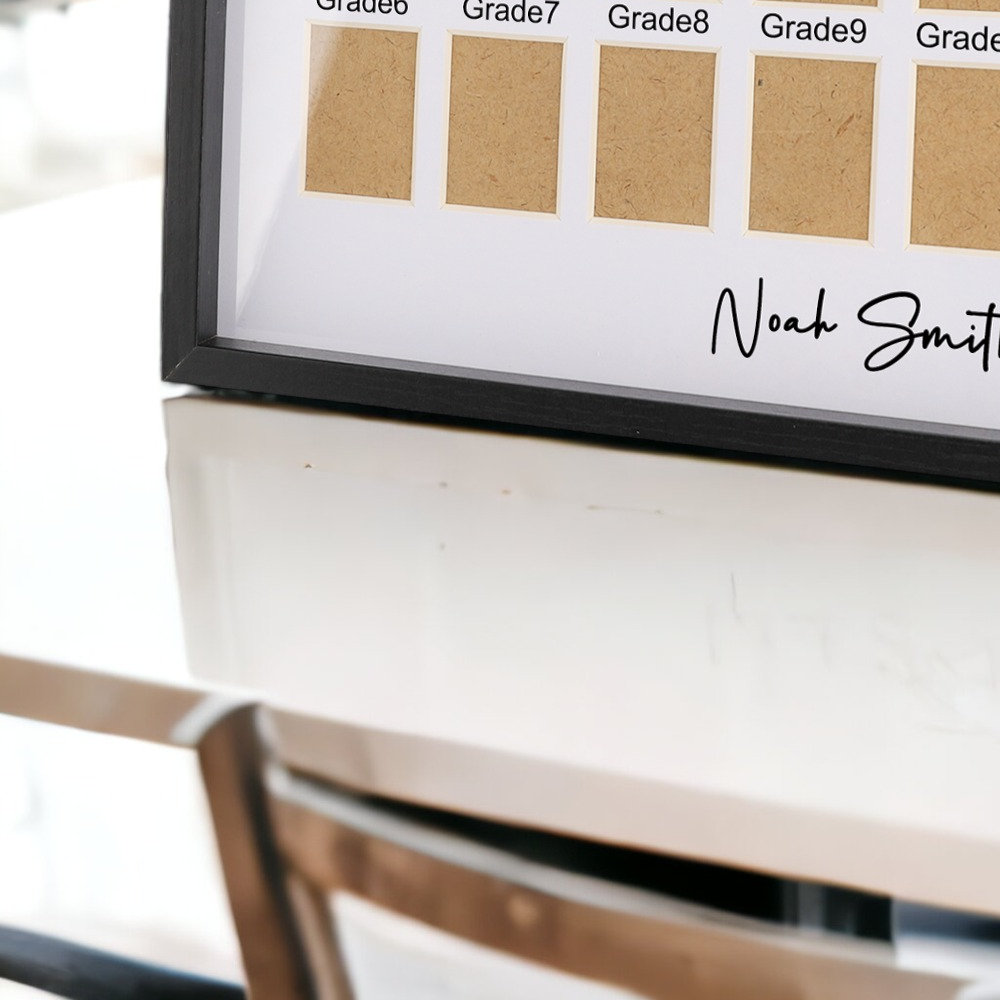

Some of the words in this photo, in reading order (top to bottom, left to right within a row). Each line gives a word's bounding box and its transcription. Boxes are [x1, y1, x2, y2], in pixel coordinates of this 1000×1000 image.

[608, 3, 710, 34] Grade8
[760, 12, 867, 44] Grade9
[711, 277, 838, 359] Noah
